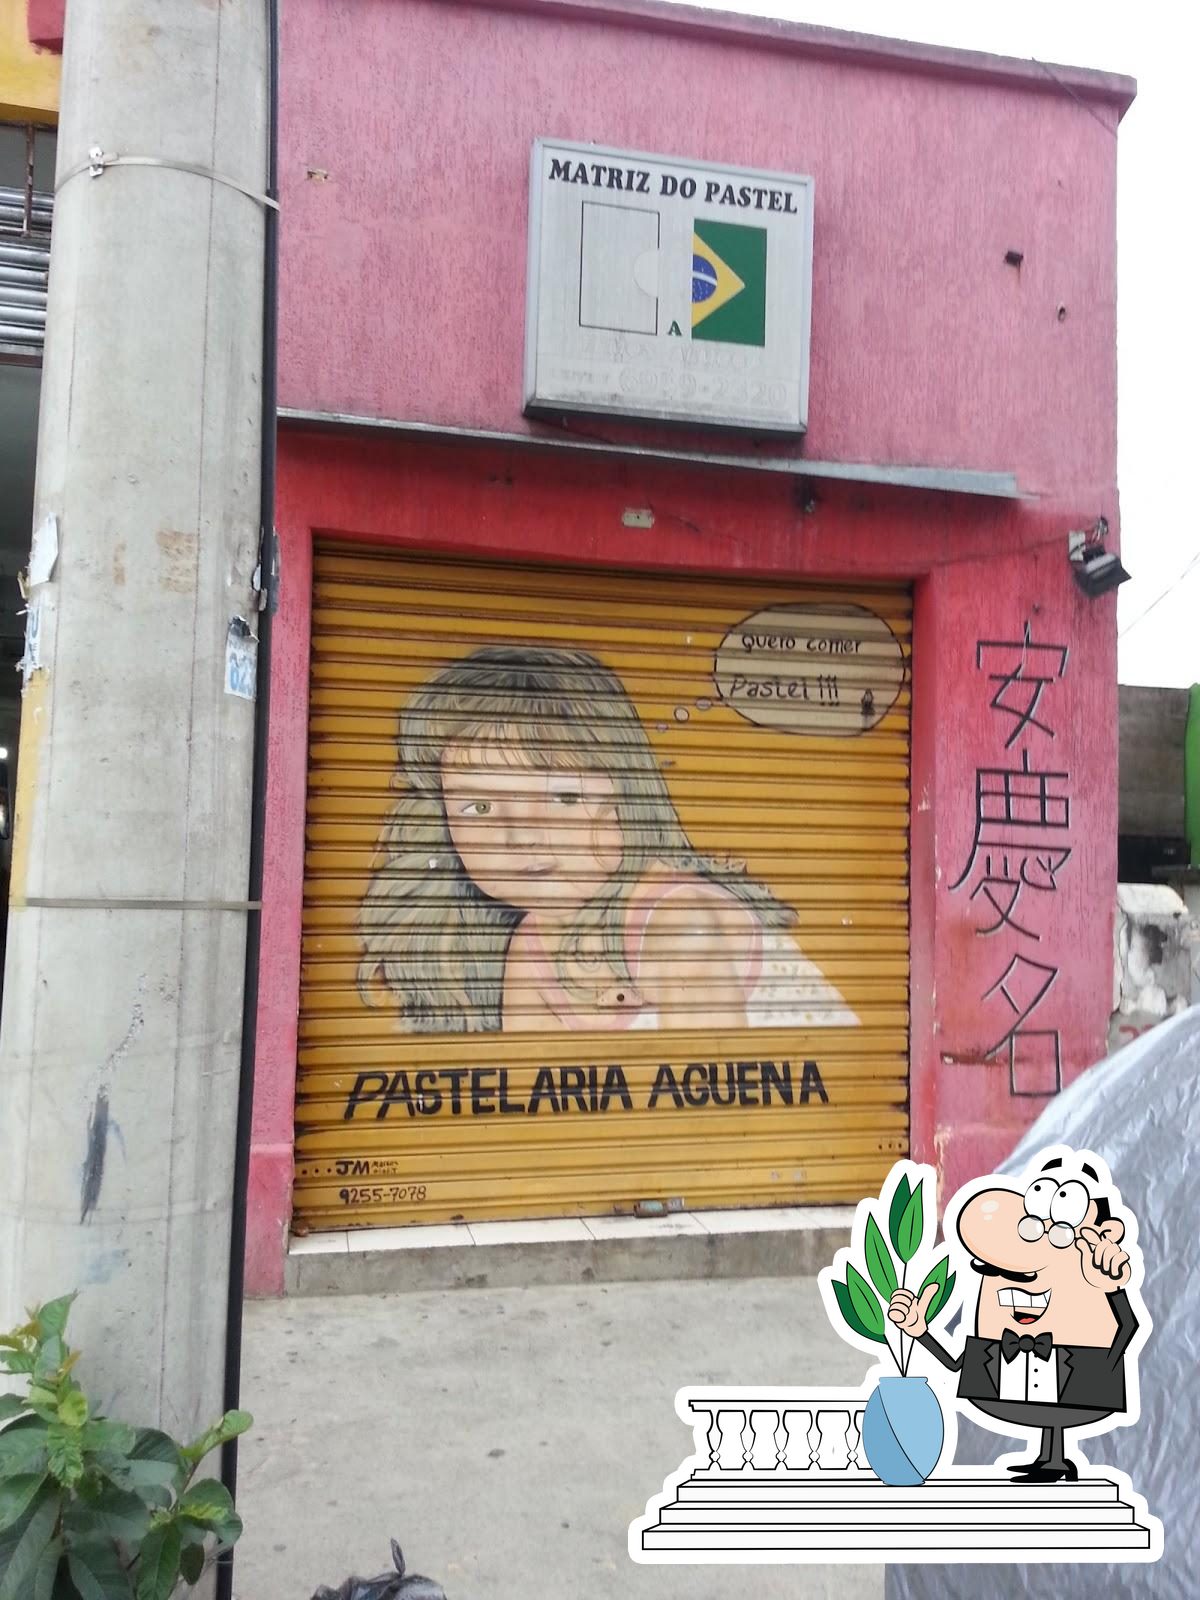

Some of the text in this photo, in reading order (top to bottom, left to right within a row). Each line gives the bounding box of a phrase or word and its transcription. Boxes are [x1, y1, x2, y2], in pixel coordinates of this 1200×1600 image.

[549, 159, 798, 213] MATRIZ DO PASTEL
[668, 321, 682, 336] A
[344, 1060, 829, 1120] PASTELARIA AGUENA
[335, 1160, 370, 1175] JM
[339, 1185, 426, 1204] 9255-7078
